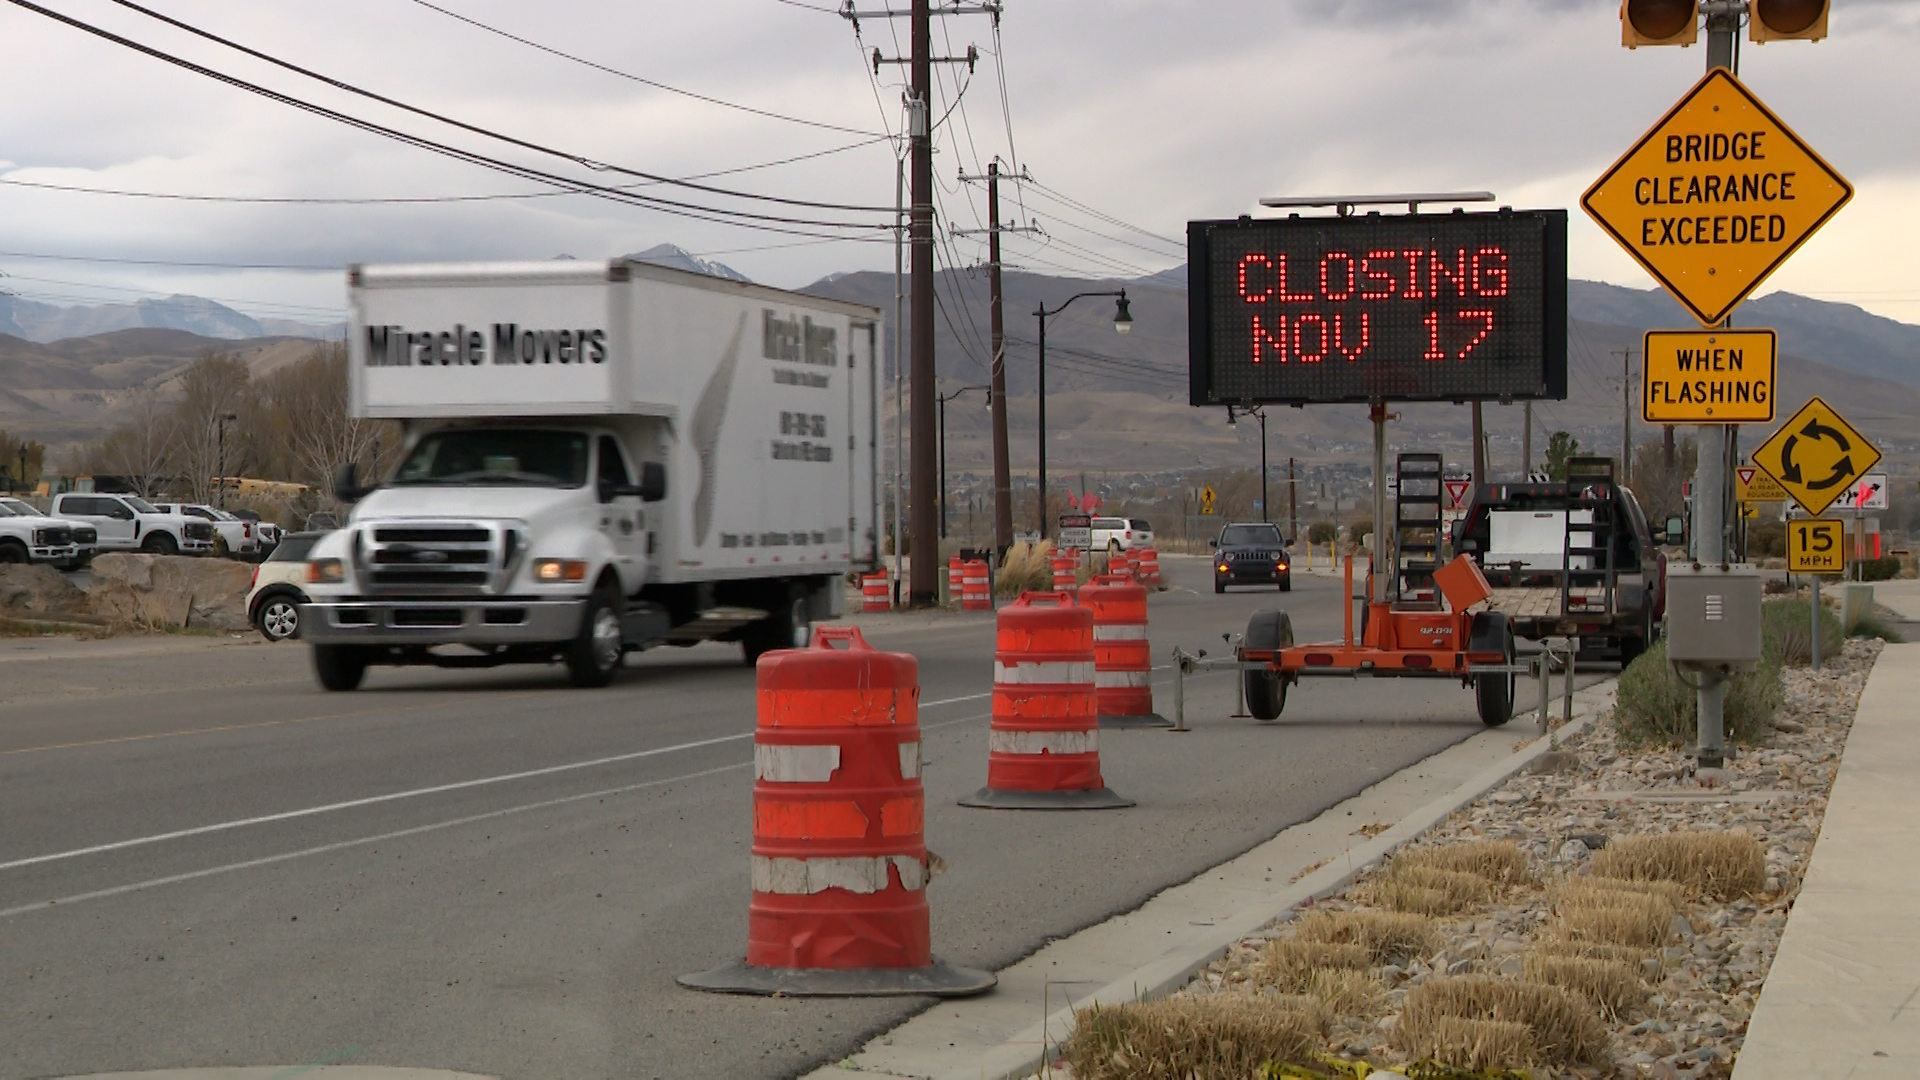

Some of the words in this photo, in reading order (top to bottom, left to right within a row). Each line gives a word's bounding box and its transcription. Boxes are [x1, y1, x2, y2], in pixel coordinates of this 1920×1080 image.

[1666, 131, 1766, 163] BRIDGE
[1635, 172, 1796, 206] CLEARANCE
[1642, 214, 1786, 246] EXCEEDED
[1238, 247, 1509, 303] CLOSING
[364, 324, 485, 366] Miracle
[491, 323, 607, 365] Movers
[1252, 312, 1370, 363] NOV
[1423, 310, 1494, 360] 17
[1676, 348, 1743, 371] WHEN
[1651, 381, 1767, 404] FLASHING
[1798, 526, 1834, 553] 15
[1800, 555, 1832, 566] MPH
